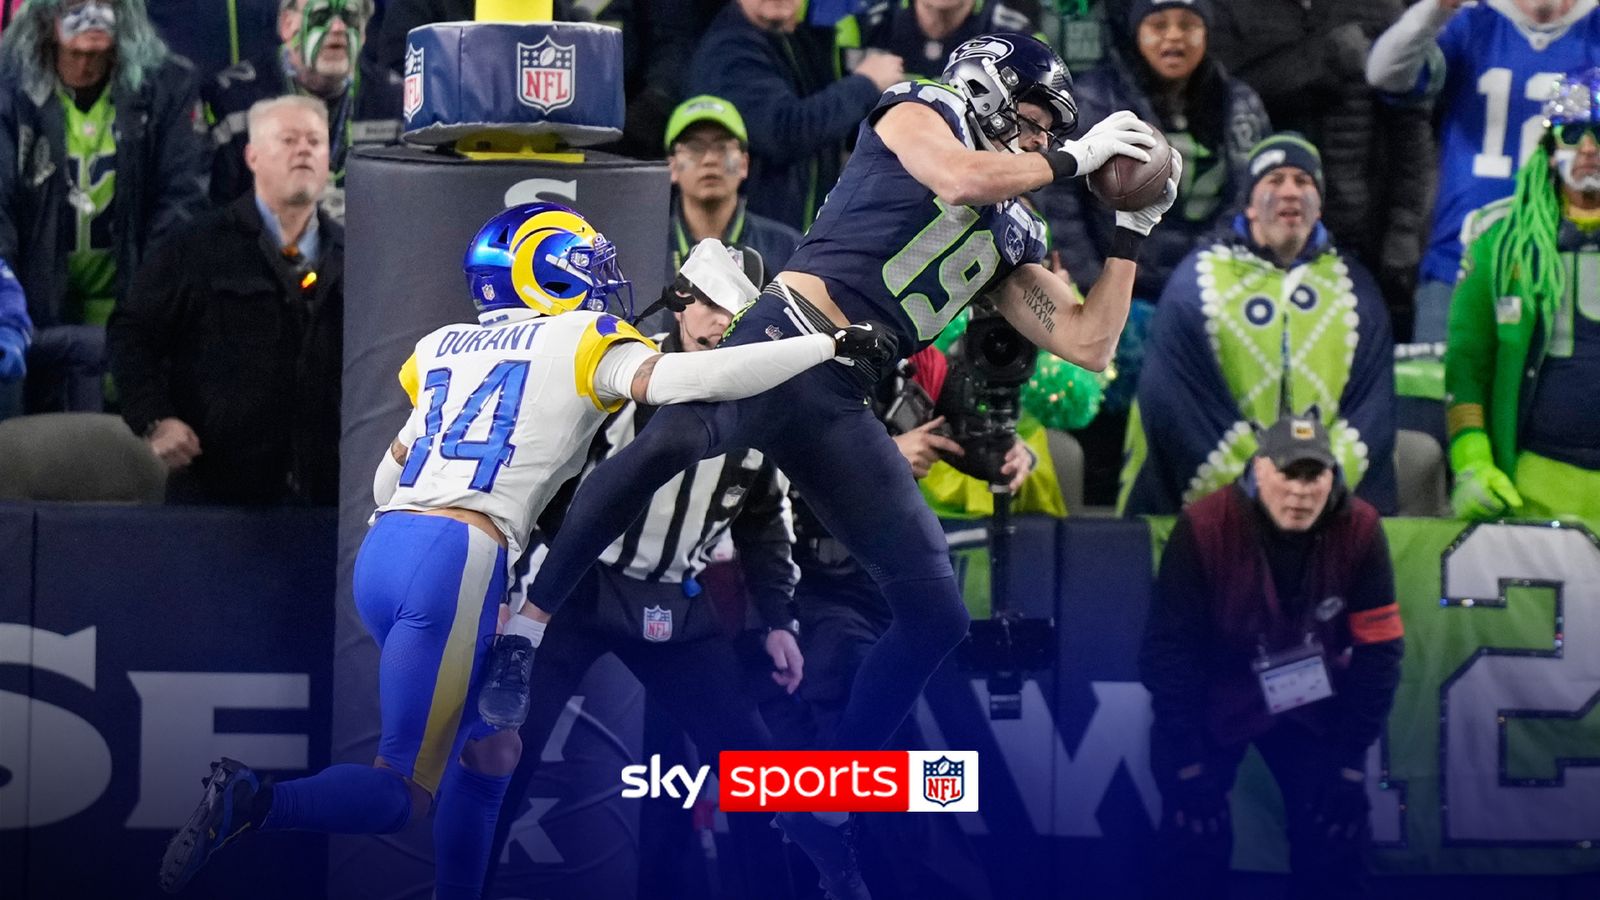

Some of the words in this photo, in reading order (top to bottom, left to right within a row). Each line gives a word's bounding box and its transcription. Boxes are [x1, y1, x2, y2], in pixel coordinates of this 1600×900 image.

[525, 71, 568, 103] NFL
[882, 195, 1001, 341] 19
[435, 322, 546, 358] DURANT
[398, 360, 532, 494] 14
